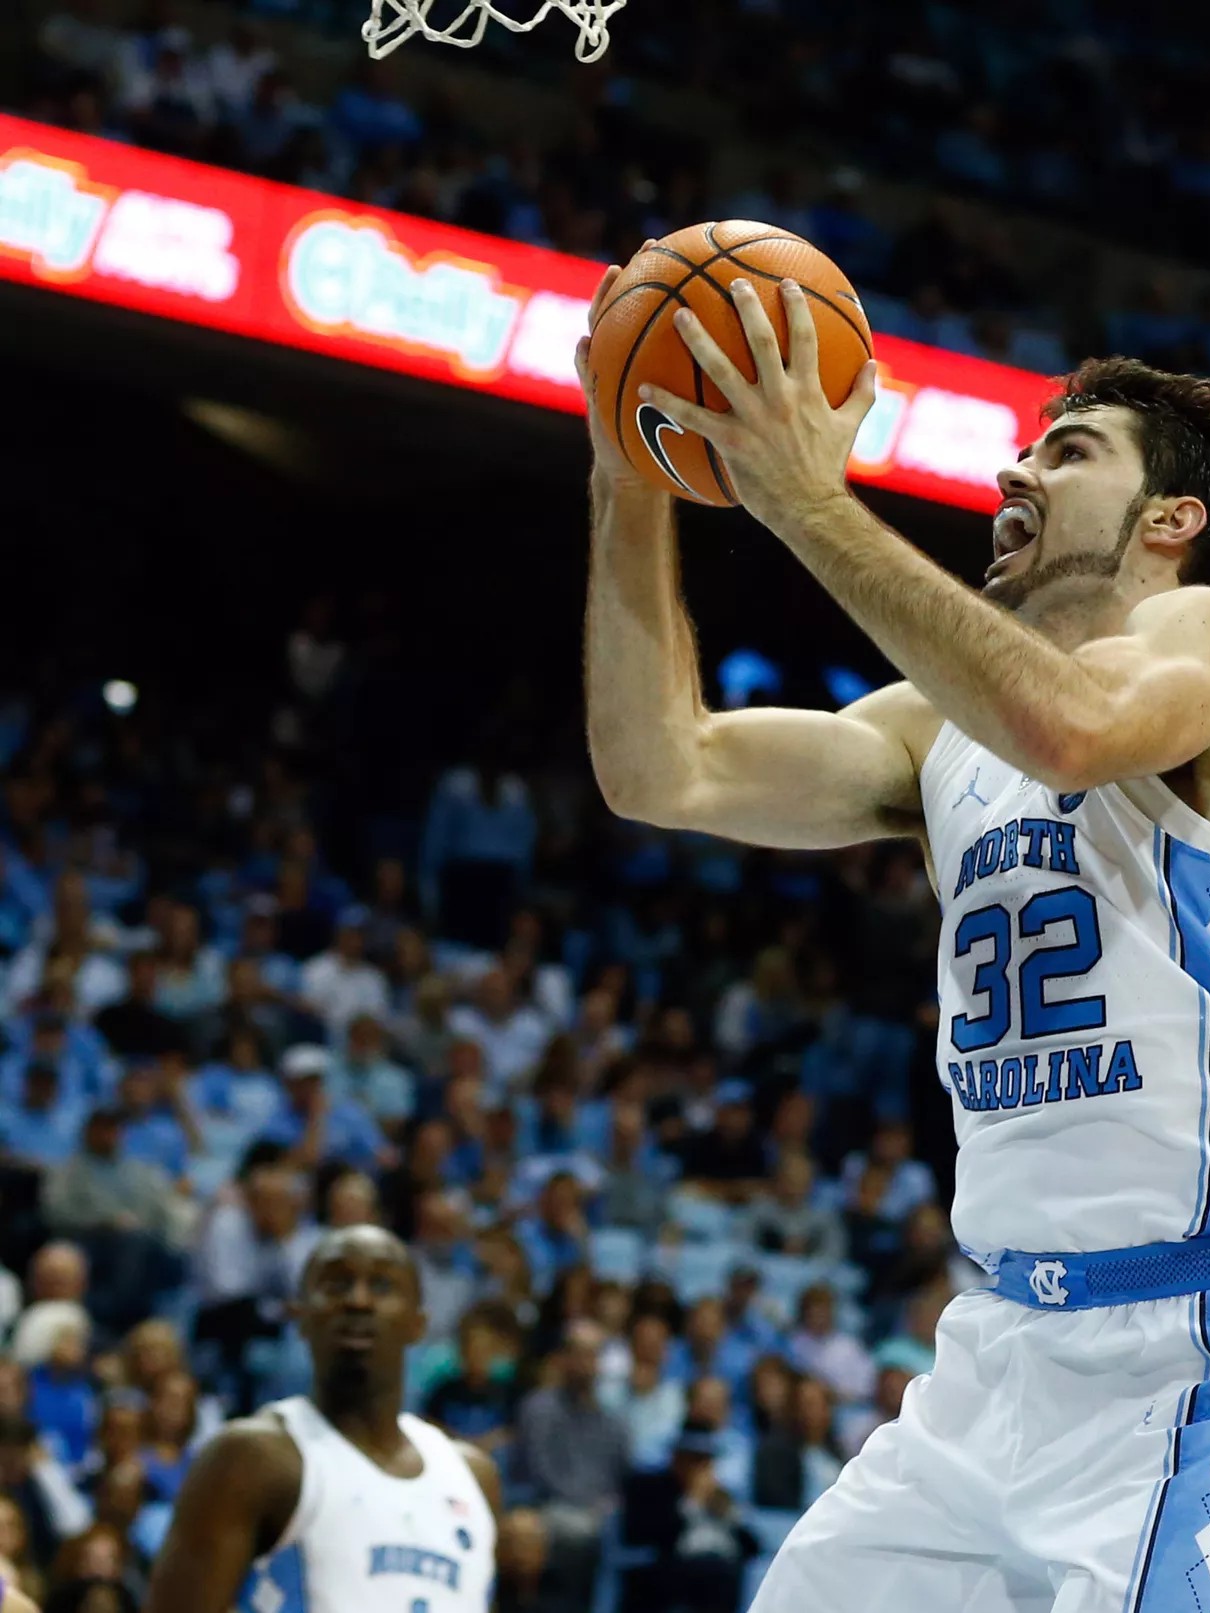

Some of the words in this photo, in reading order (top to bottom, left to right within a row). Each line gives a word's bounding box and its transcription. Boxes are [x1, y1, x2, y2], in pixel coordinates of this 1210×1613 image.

[953, 818, 1080, 900] NORTH
[950, 885, 1106, 1053] 32
[948, 1040, 1143, 1112] CAROLINA
